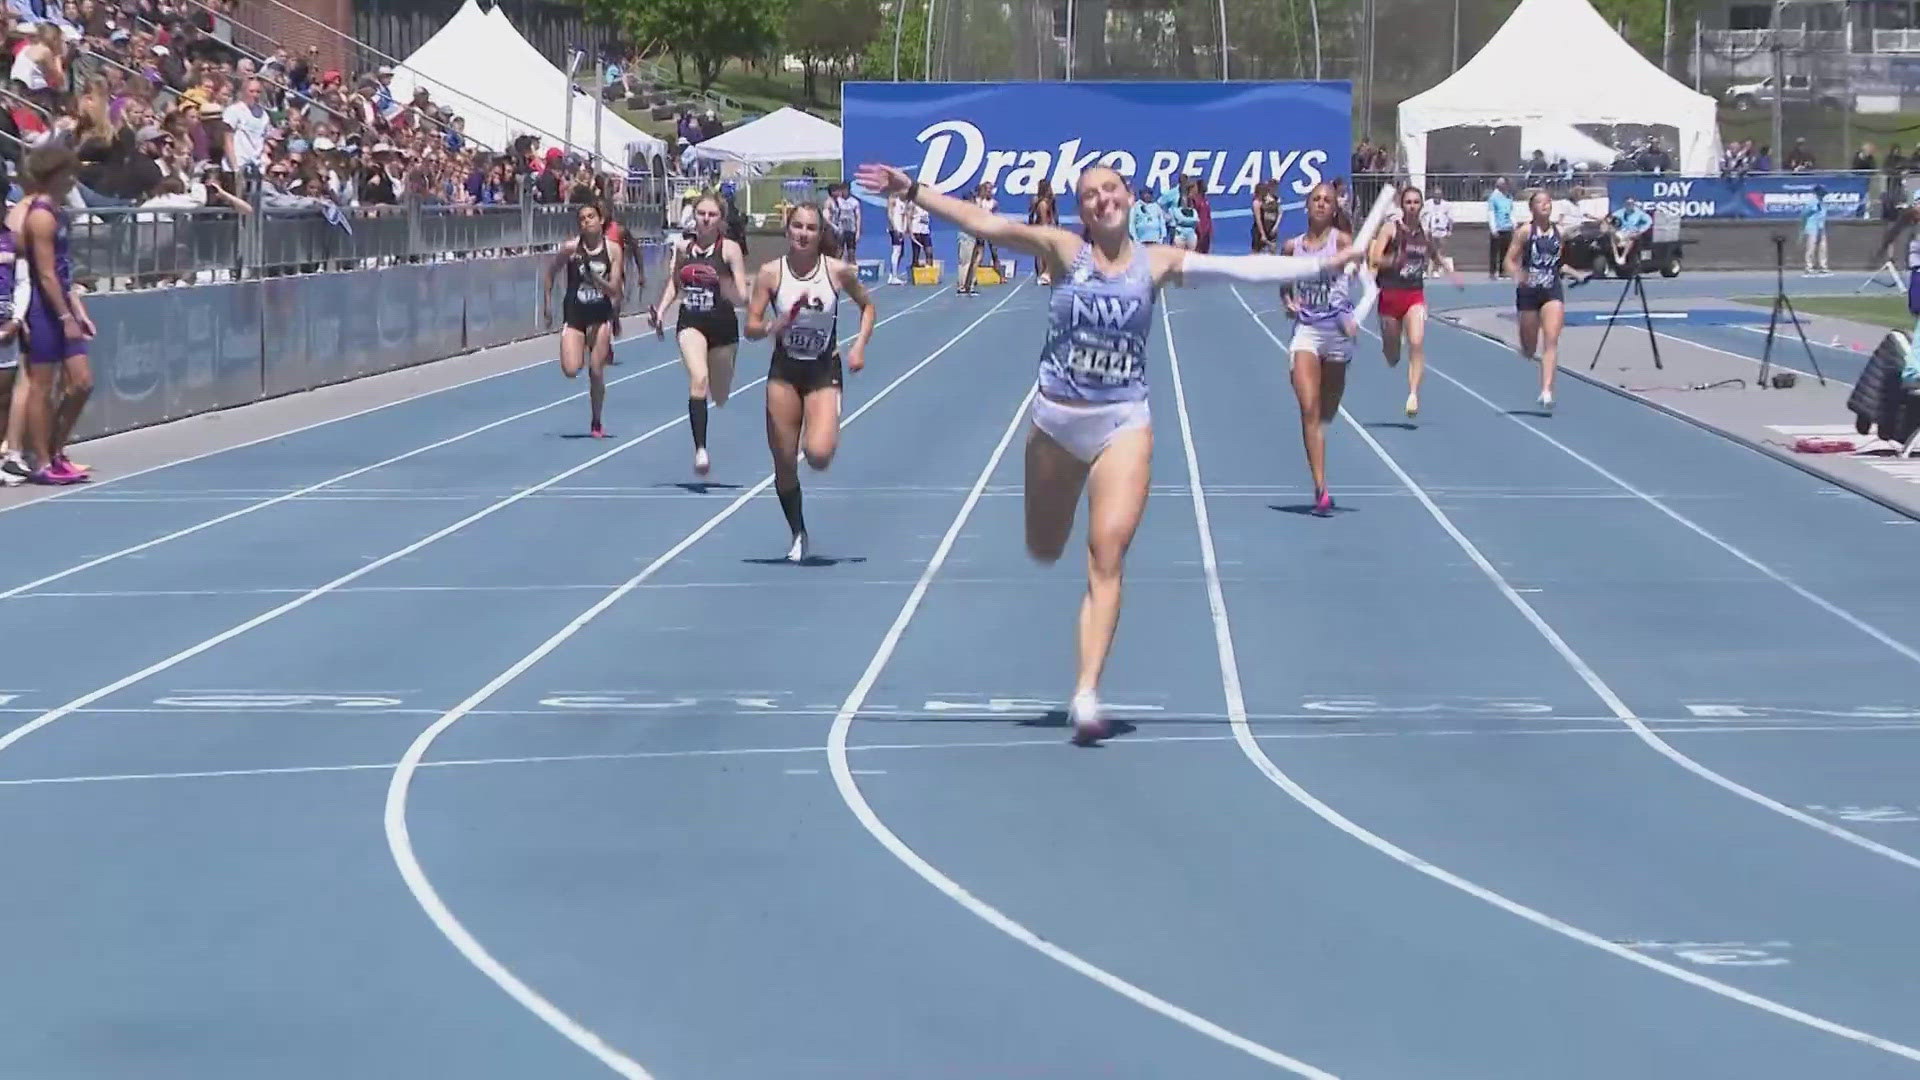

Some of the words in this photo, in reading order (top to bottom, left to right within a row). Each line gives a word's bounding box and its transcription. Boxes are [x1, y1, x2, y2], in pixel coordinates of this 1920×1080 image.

[915, 120, 1137, 195] Drake
[1145, 151, 1328, 195] RELAYS
[1653, 181, 1693, 197] DAY
[1071, 293, 1140, 329] NW
